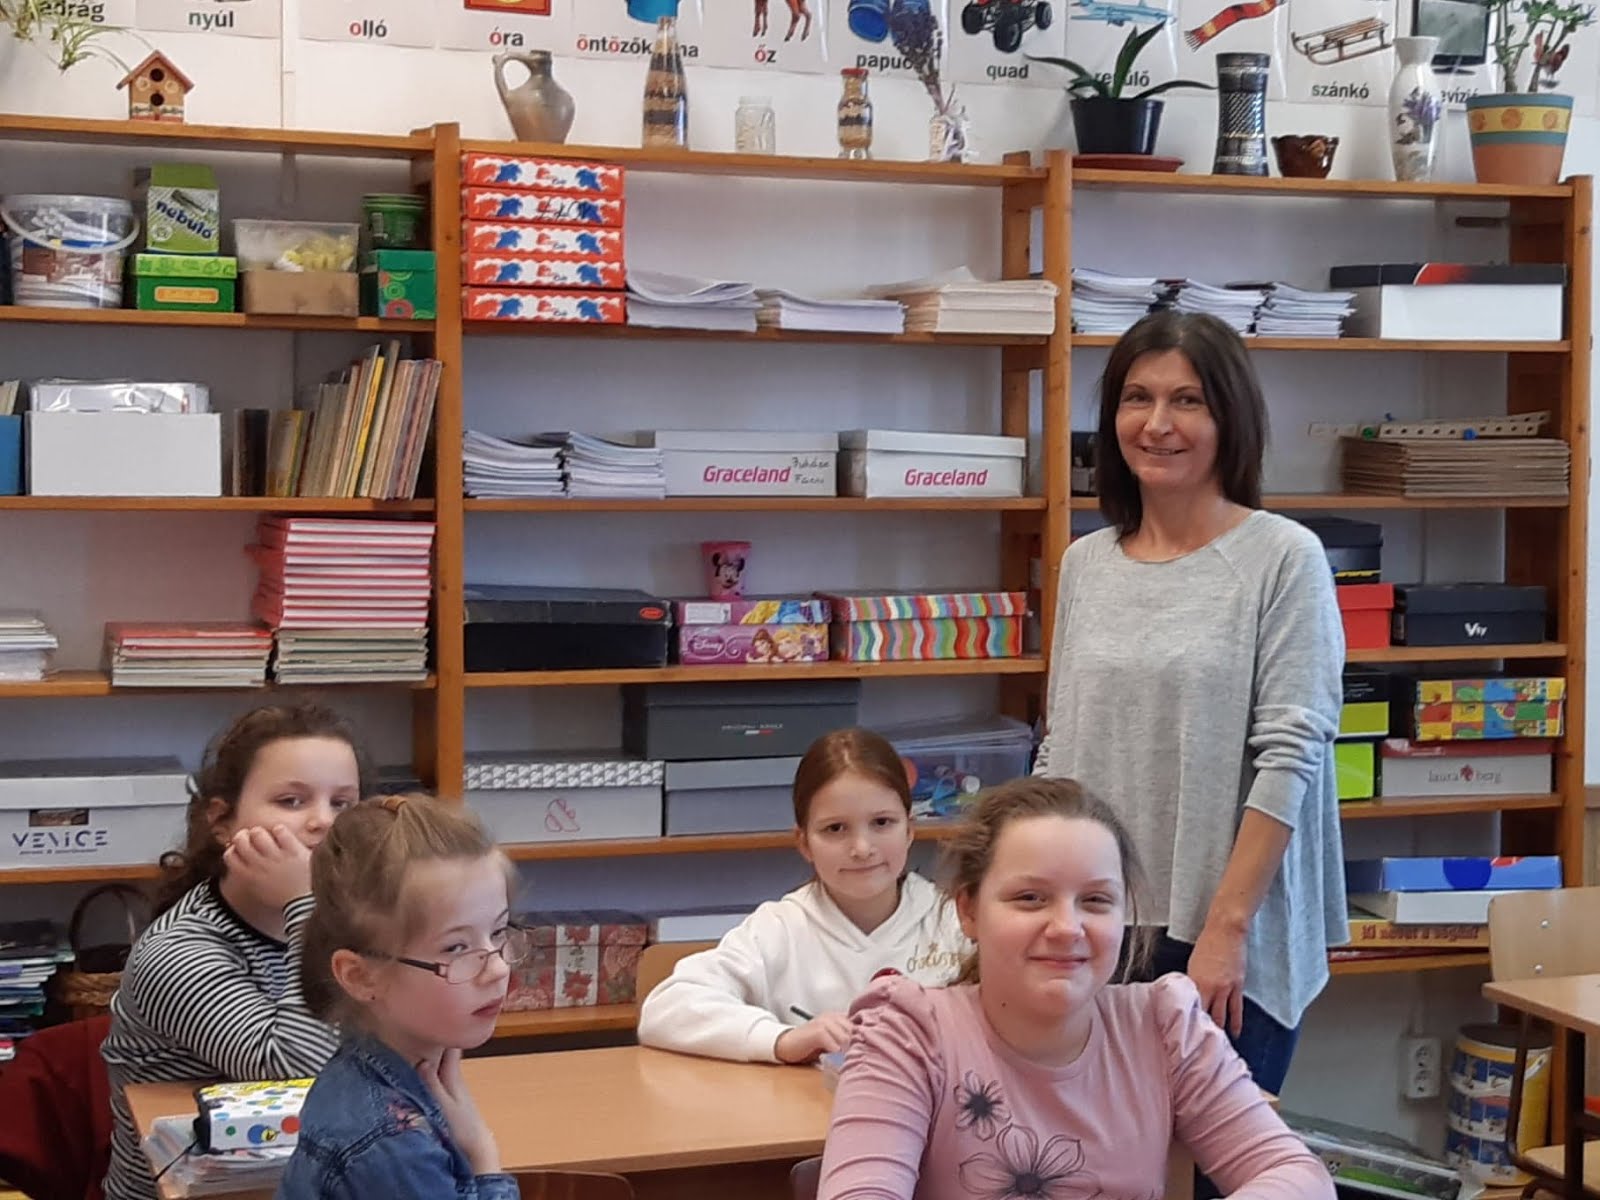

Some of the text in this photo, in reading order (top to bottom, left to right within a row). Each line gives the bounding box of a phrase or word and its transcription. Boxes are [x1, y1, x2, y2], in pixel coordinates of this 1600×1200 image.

[38, 0, 105, 22] adrág
[188, 10, 234, 29] nyúl
[349, 18, 388, 38] olló
[489, 26, 524, 46] óra
[576, 34, 699, 57] öntözőkna
[754, 44, 777, 63] őz
[986, 64, 1029, 81] quad
[1311, 81, 1370, 99] szánkó
[156, 200, 215, 239] nebuló
[703, 465, 792, 483] Graceland
[904, 468, 988, 486] Graceland
